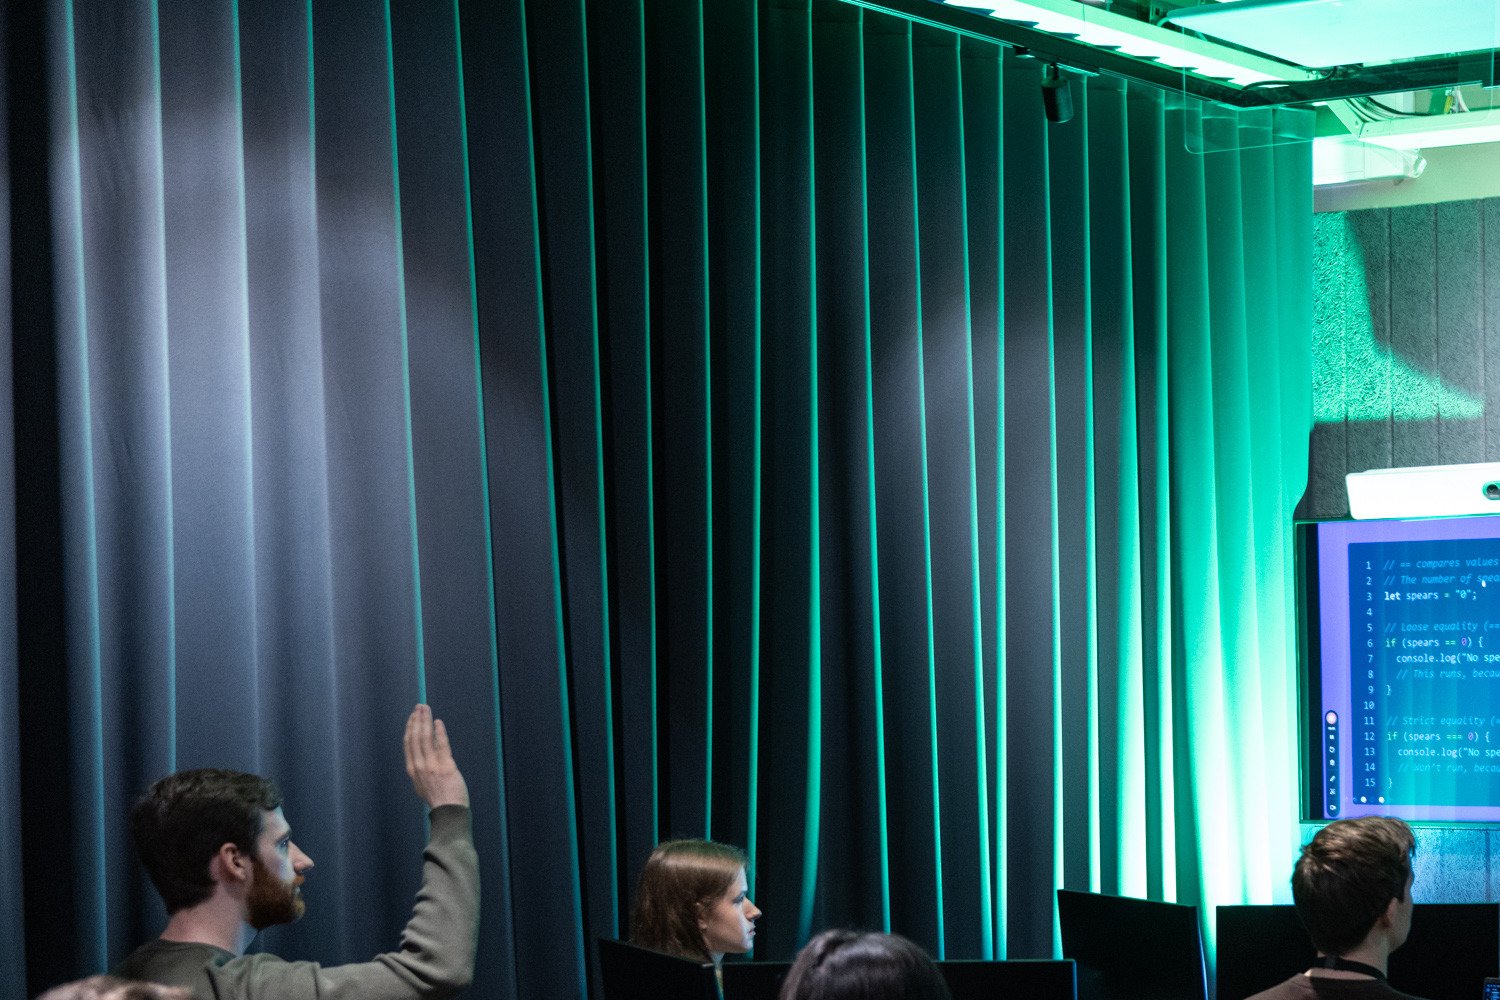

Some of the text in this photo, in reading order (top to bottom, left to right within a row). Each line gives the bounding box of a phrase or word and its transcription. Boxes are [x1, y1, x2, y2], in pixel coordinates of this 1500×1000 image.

[1366, 576, 1372, 585] 2
[1367, 592, 1372, 601] 3
[1385, 591, 1401, 601] let
[1406, 592, 1439, 602] spears
[1367, 608, 1373, 616] 4
[1368, 623, 1373, 632] 5
[1368, 639, 1373, 648] 6
[1386, 638, 1396, 648] if
[1402, 638, 1440, 649] (spears
[1461, 637, 1472, 648] 0)
[1478, 636, 1483, 648] {
[1368, 654, 1373, 663] 7
[1368, 685, 1374, 694] 9
[1364, 701, 1375, 710] 10
[1365, 732, 1375, 740] 12
[1387, 731, 1398, 741] if
[1404, 731, 1441, 742] (spears
[1468, 731, 1479, 743] 0)
[1485, 731, 1490, 743] {
[1365, 747, 1375, 756] 13
[1366, 778, 1376, 787] 15
